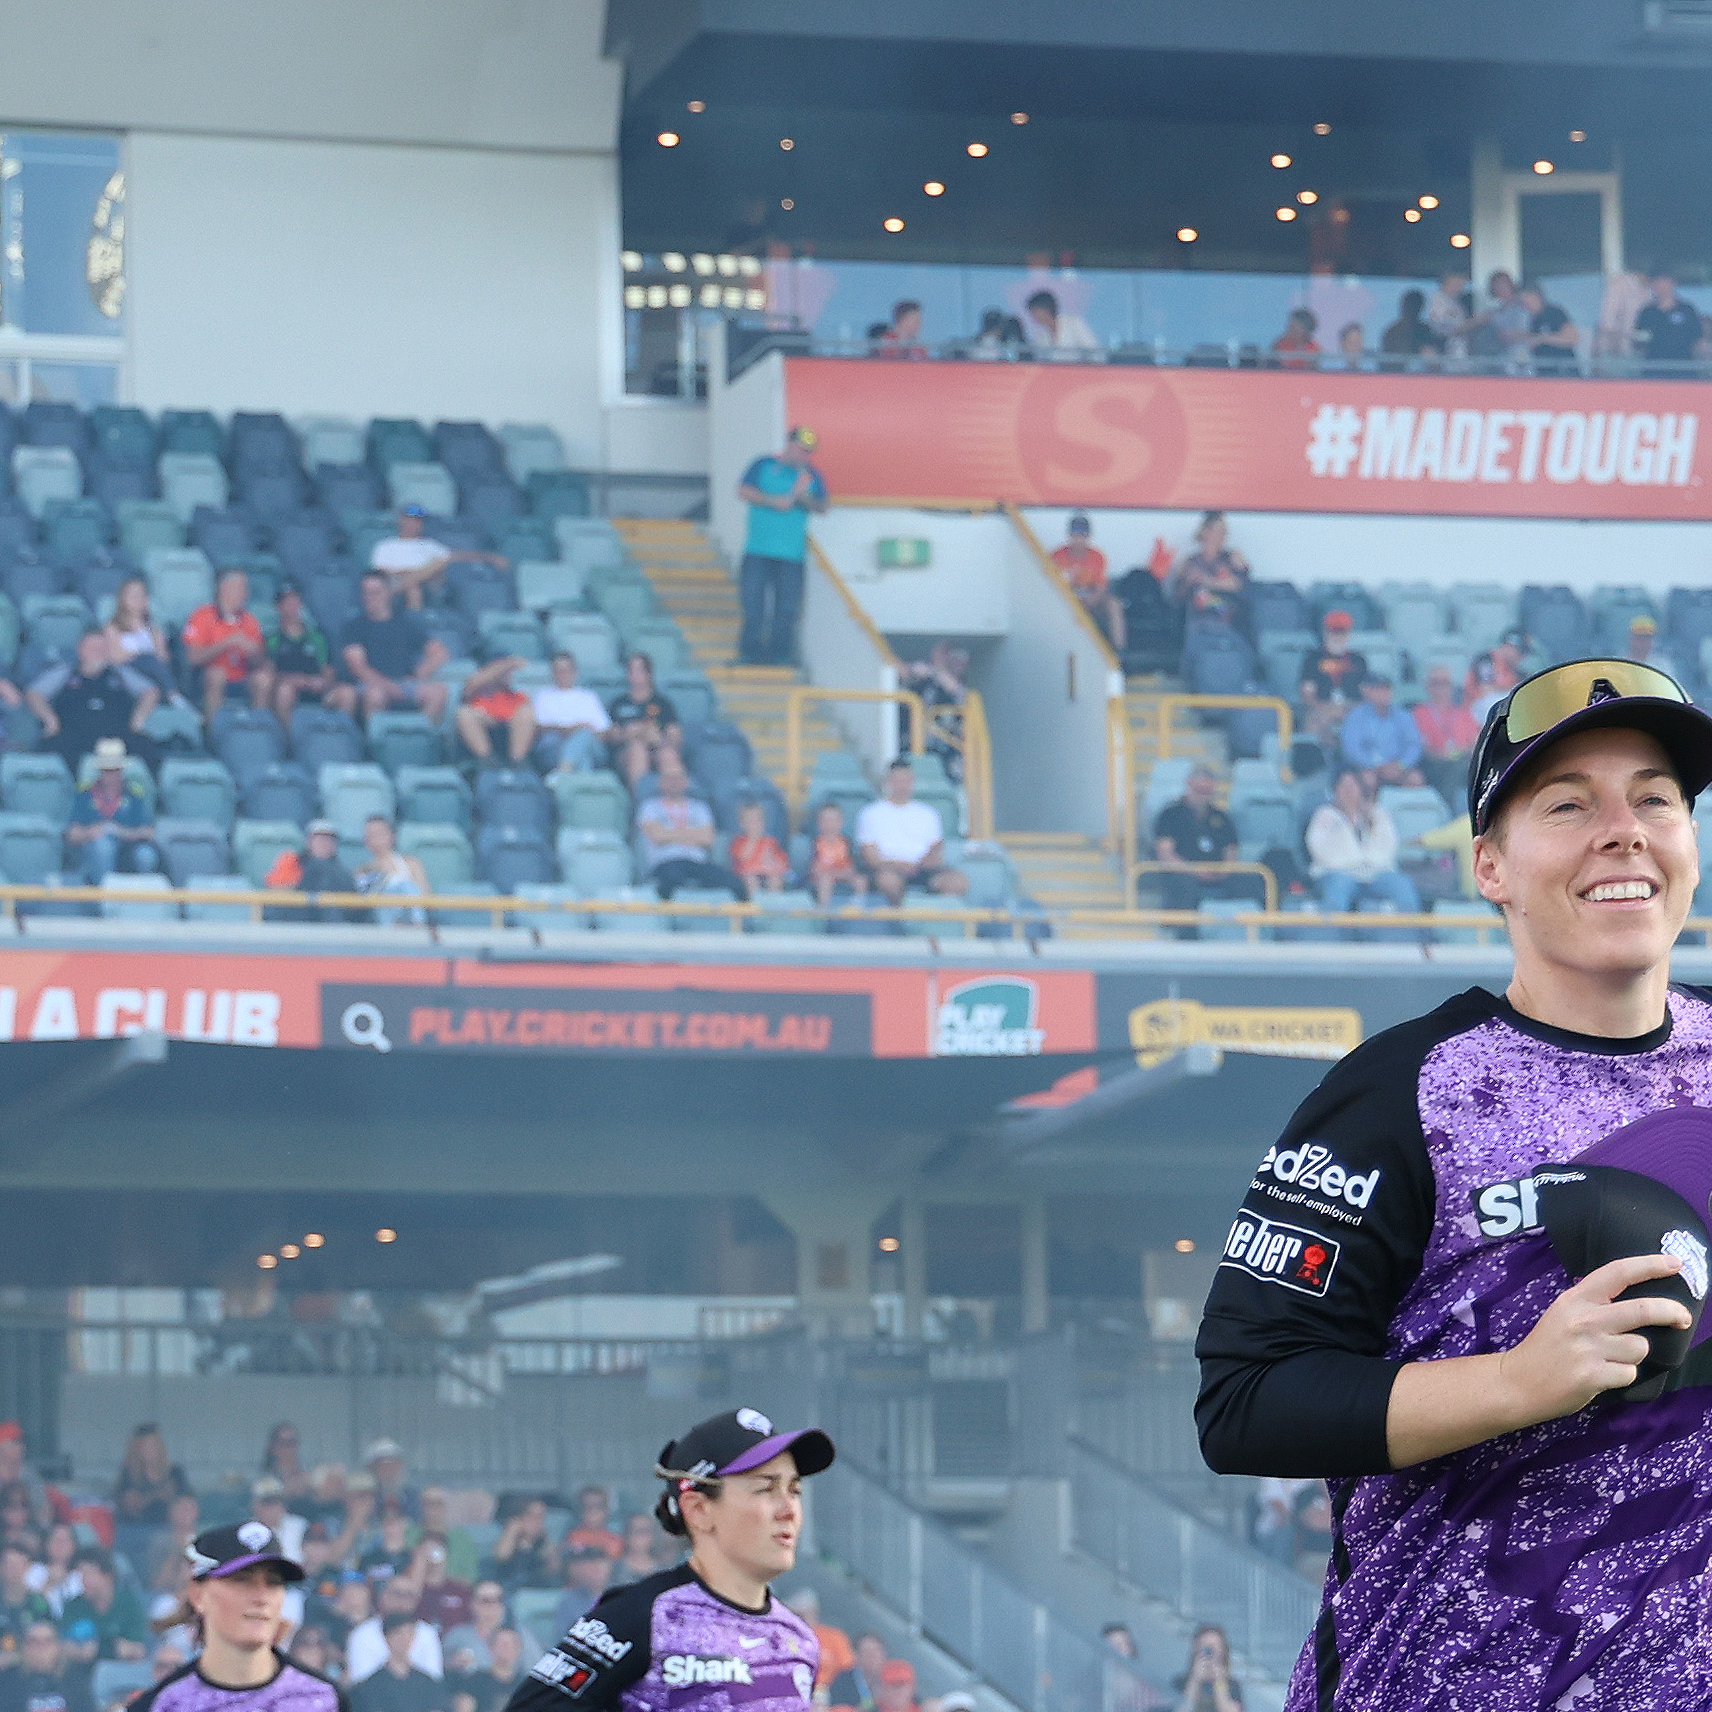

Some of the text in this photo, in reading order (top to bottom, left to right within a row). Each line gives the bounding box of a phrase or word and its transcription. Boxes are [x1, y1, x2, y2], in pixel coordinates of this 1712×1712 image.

[1306, 405, 1699, 486] #MADETOUGH
[30, 986, 79, 1042] A
[95, 988, 282, 1048] CLUB
[1223, 1219, 1302, 1275] eber
[662, 1655, 754, 1685] Shark
